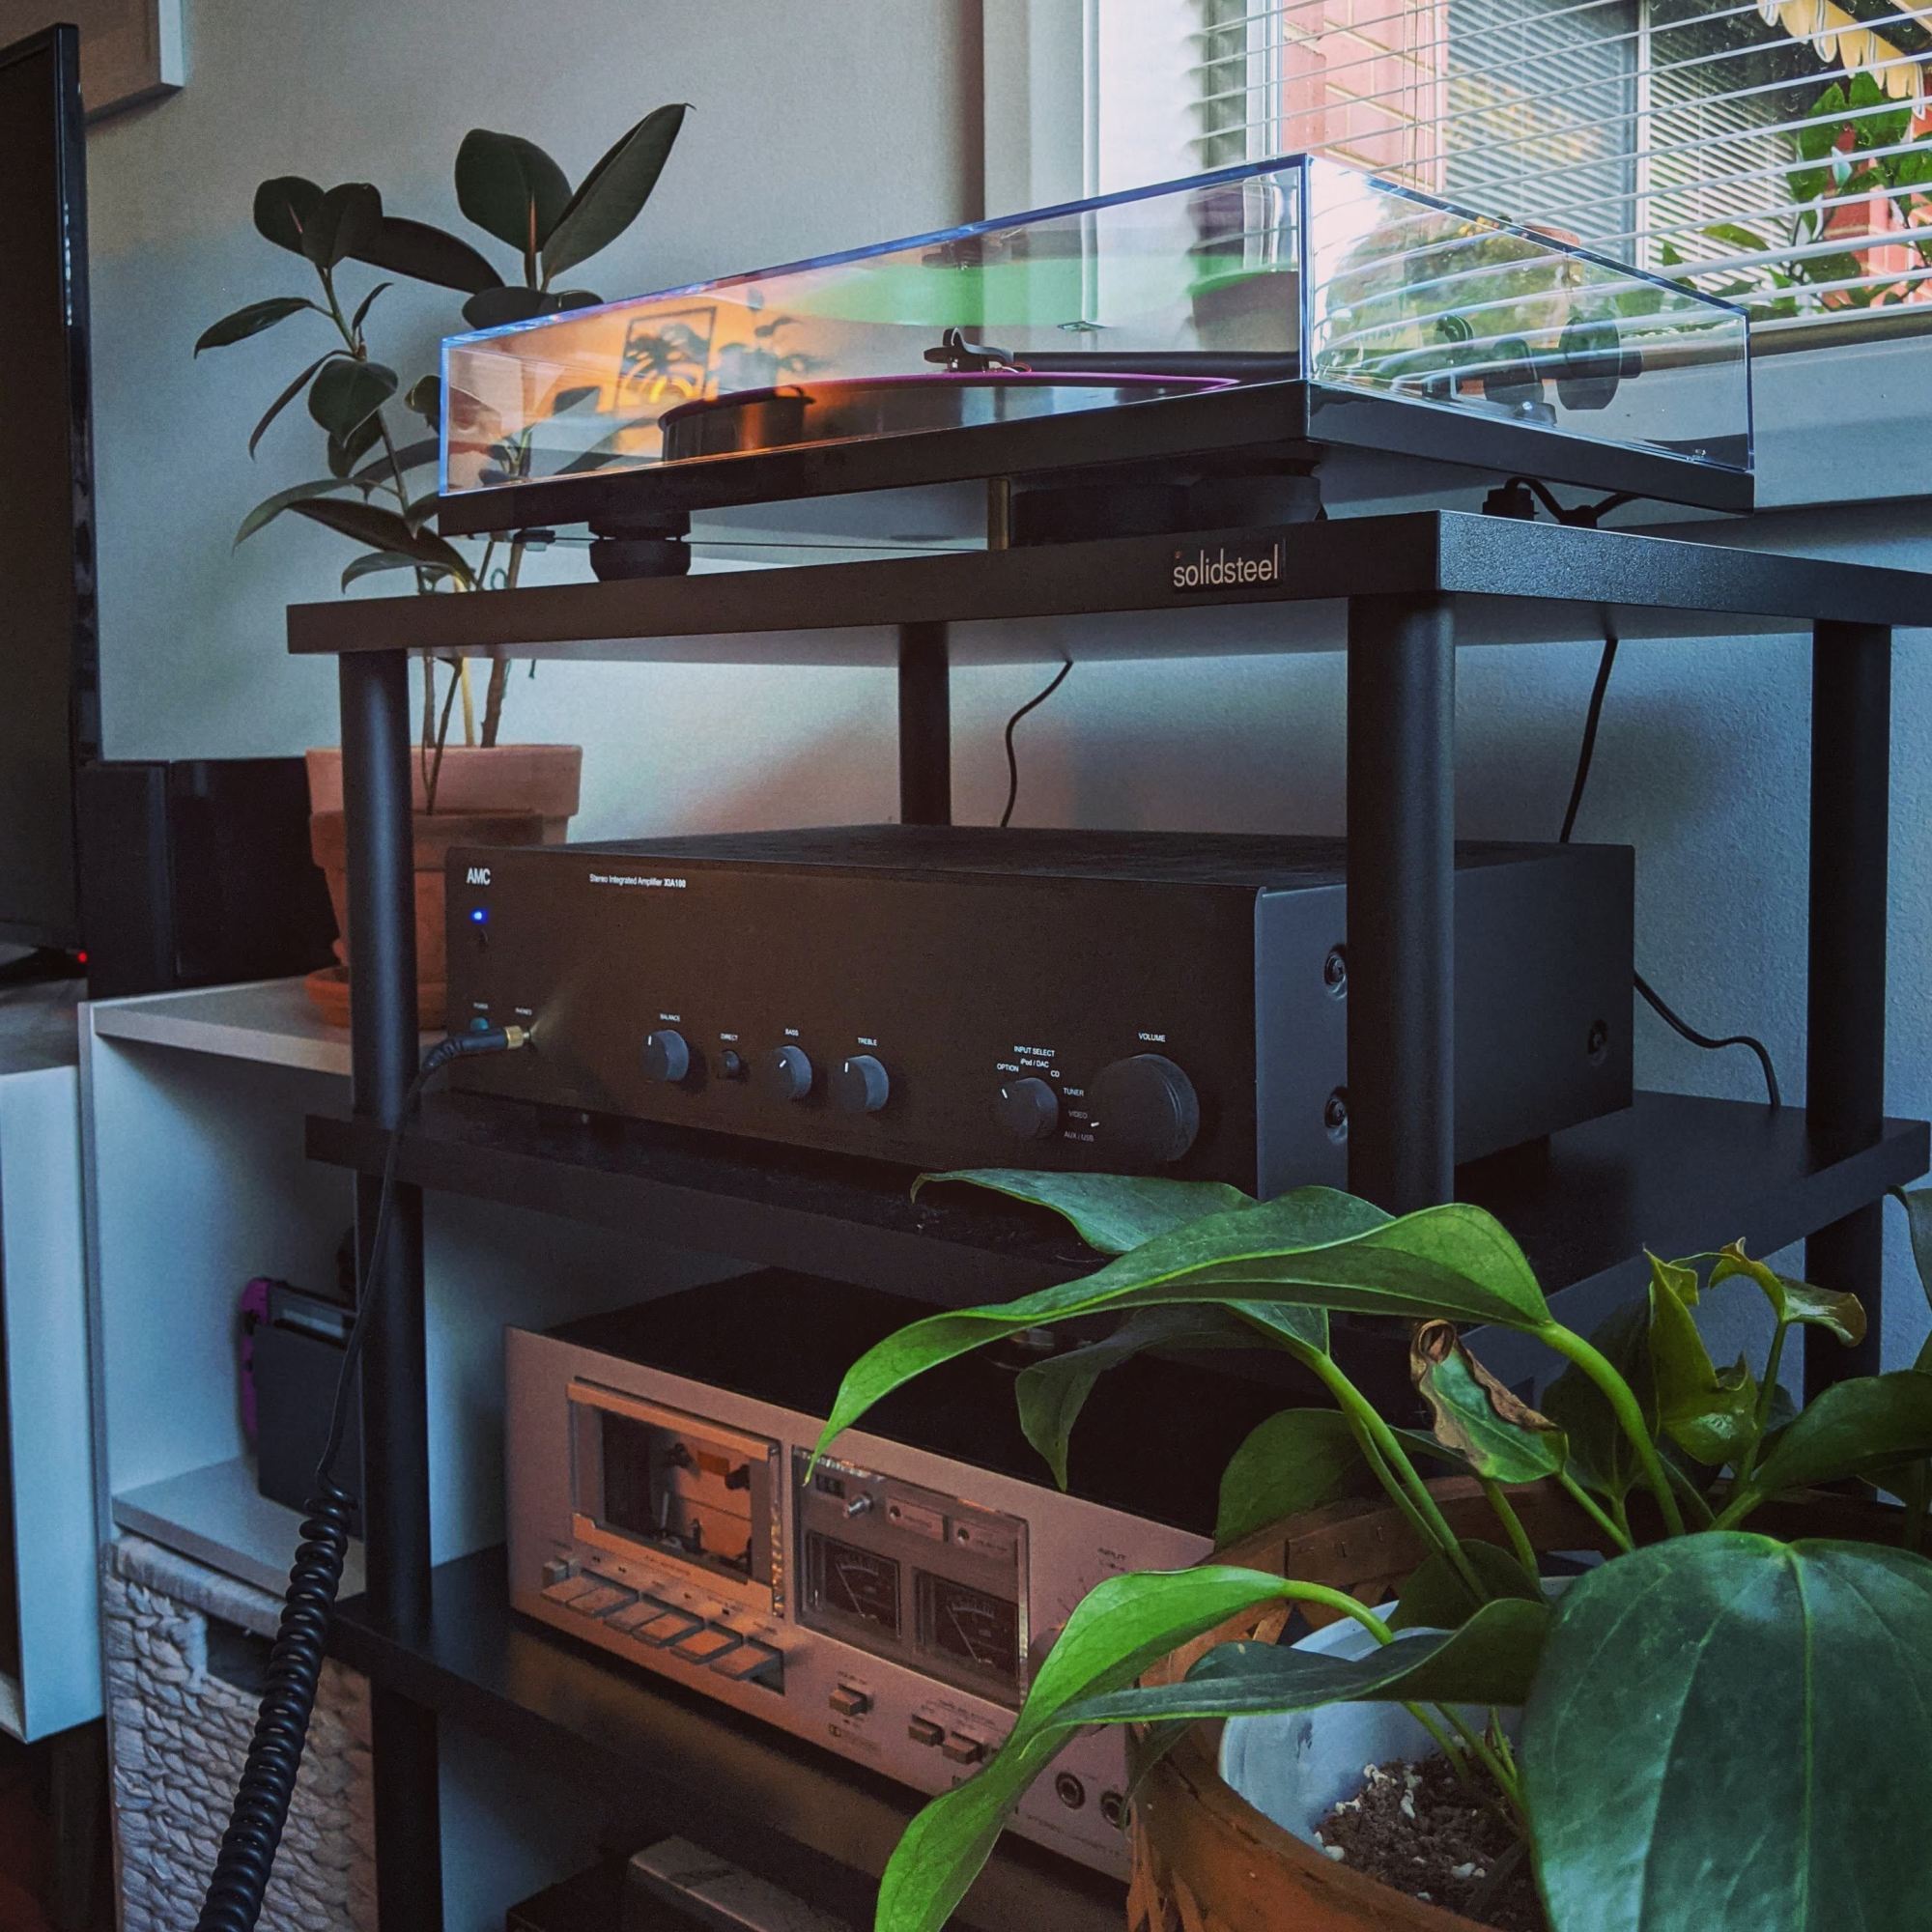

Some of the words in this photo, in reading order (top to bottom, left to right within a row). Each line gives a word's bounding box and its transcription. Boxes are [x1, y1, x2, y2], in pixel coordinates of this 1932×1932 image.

[1173, 543, 1278, 587] solidsteel
[466, 867, 491, 886] AMC
[589, 873, 609, 883] Stereo
[610, 875, 638, 887] Integrated
[638, 877, 663, 888] Amplifier
[784, 1028, 800, 1037] BASS
[1138, 1032, 1166, 1043] VOLUME
[857, 1037, 877, 1046] TREBLE
[1013, 1045, 1032, 1054] INPUT
[1033, 1047, 1056, 1058] SELECT
[996, 1063, 1020, 1072] OPTION
[1037, 1060, 1050, 1068] DAC
[1050, 1069, 1060, 1078] CD
[1063, 1088, 1085, 1097] TUNER
[1067, 1110, 1089, 1120] VIDEO
[1064, 1131, 1077, 1141] AUX
